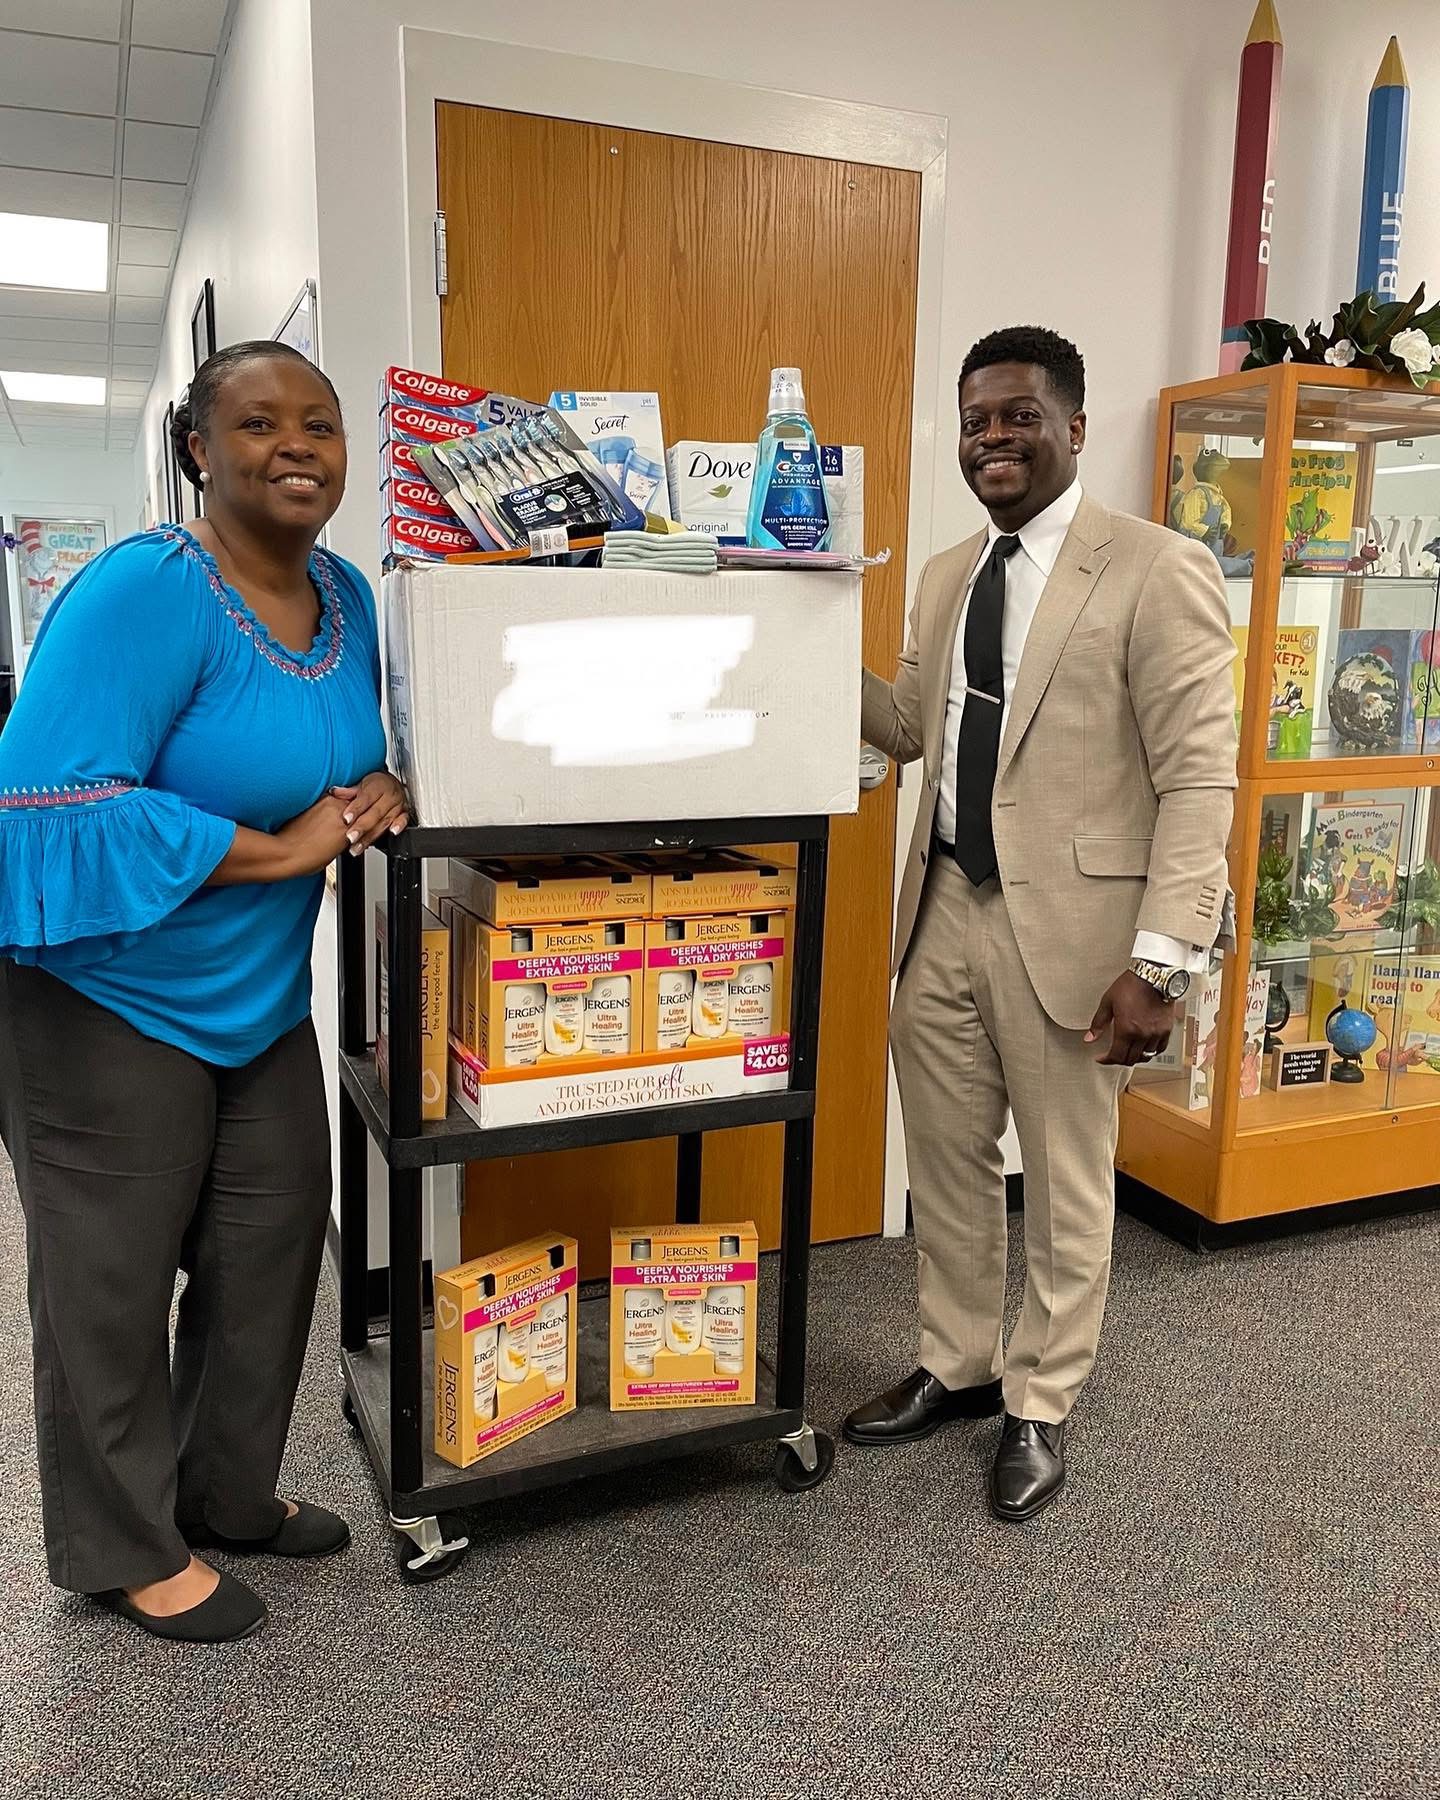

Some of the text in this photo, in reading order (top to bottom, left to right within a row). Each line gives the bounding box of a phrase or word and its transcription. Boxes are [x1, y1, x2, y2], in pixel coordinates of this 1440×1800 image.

[1377, 191, 1405, 296] BLUE
[393, 369, 470, 401] Colgate
[560, 394, 571, 406] 5
[489, 400, 506, 425] 5
[393, 408, 471, 438] Colgate
[591, 414, 630, 435] Secret
[688, 450, 752, 479] Dove
[777, 461, 816, 473] Crest
[825, 455, 838, 466] 16
[1291, 457, 1306, 469] he
[771, 478, 821, 486] ADVANTAGE
[1289, 471, 1352, 490] rincipal
[396, 483, 446, 505] Colg
[512, 487, 542, 502] Oral-B
[688, 522, 729, 533] original
[764, 517, 828, 525] MULTI-PROTECTION
[396, 520, 472, 547] Colgate
[48, 534, 96, 550] GREAT
[1279, 633, 1299, 642] FULL
[1273, 652, 1305, 668] KET?
[1316, 810, 1383, 836] Miss Bindergarten
[1345, 829, 1363, 840] Gets
[1364, 821, 1389, 839] Ready
[1353, 843, 1395, 866] Kindergarten
[762, 887, 791, 896] JERGENS
[615, 895, 645, 904] JERGENS
[696, 923, 740, 938] JERGENS
[545, 934, 595, 949] JERGENS
[671, 940, 764, 957] DEEPLY NOURISHES
[518, 952, 620, 969] DEEPLY NOURISHES
[678, 950, 757, 965] EXTRA DRY SKIN
[525, 962, 613, 978] EXTRA DRY SKIN
[728, 983, 771, 997] JERGENS
[1204, 978, 1267, 1004] Mr. oln's
[1372, 978, 1423, 992] love to
[584, 997, 630, 1011] JERGENS
[657, 991, 693, 1006] JERGENS
[740, 999, 759, 1007] Ultra
[505, 1003, 545, 1022] JERGENS
[597, 1014, 617, 1022] Ultra
[668, 1007, 685, 1016] Ultra
[734, 1006, 764, 1015] Healing
[517, 1022, 535, 1031] Ultra
[591, 1022, 623, 1031] Healing
[662, 1015, 687, 1025] Healing
[511, 1029, 539, 1040] Healing
[747, 1044, 779, 1057] SAVE
[746, 1053, 788, 1069] $4.00
[556, 1063, 685, 1099] TRUSTED FOR soft
[535, 1082, 715, 1117] AND OH-SO-SMOOTH SKIN
[662, 1246, 708, 1259] JERGENS
[636, 1264, 734, 1275] DEEPLY NOURISHES
[504, 1265, 543, 1291] JERGENS
[643, 1273, 726, 1284] EXTRA DRY SKIN
[483, 1296, 514, 1315] DEEPLY
[515, 1275, 561, 1299] NOURISHES
[489, 1286, 556, 1322] EXTRA DRY SKIN
[704, 1302, 745, 1316] JERGENS
[624, 1305, 664, 1320] JERGENS
[529, 1312, 568, 1335] JERGENS
[634, 1322, 653, 1330] Ultra
[710, 1326, 739, 1335] Healing
[714, 1319, 733, 1327] Ultra
[542, 1332, 559, 1341] Ultra
[629, 1329, 657, 1338] Healing
[442, 1356, 459, 1446] JERGENS
